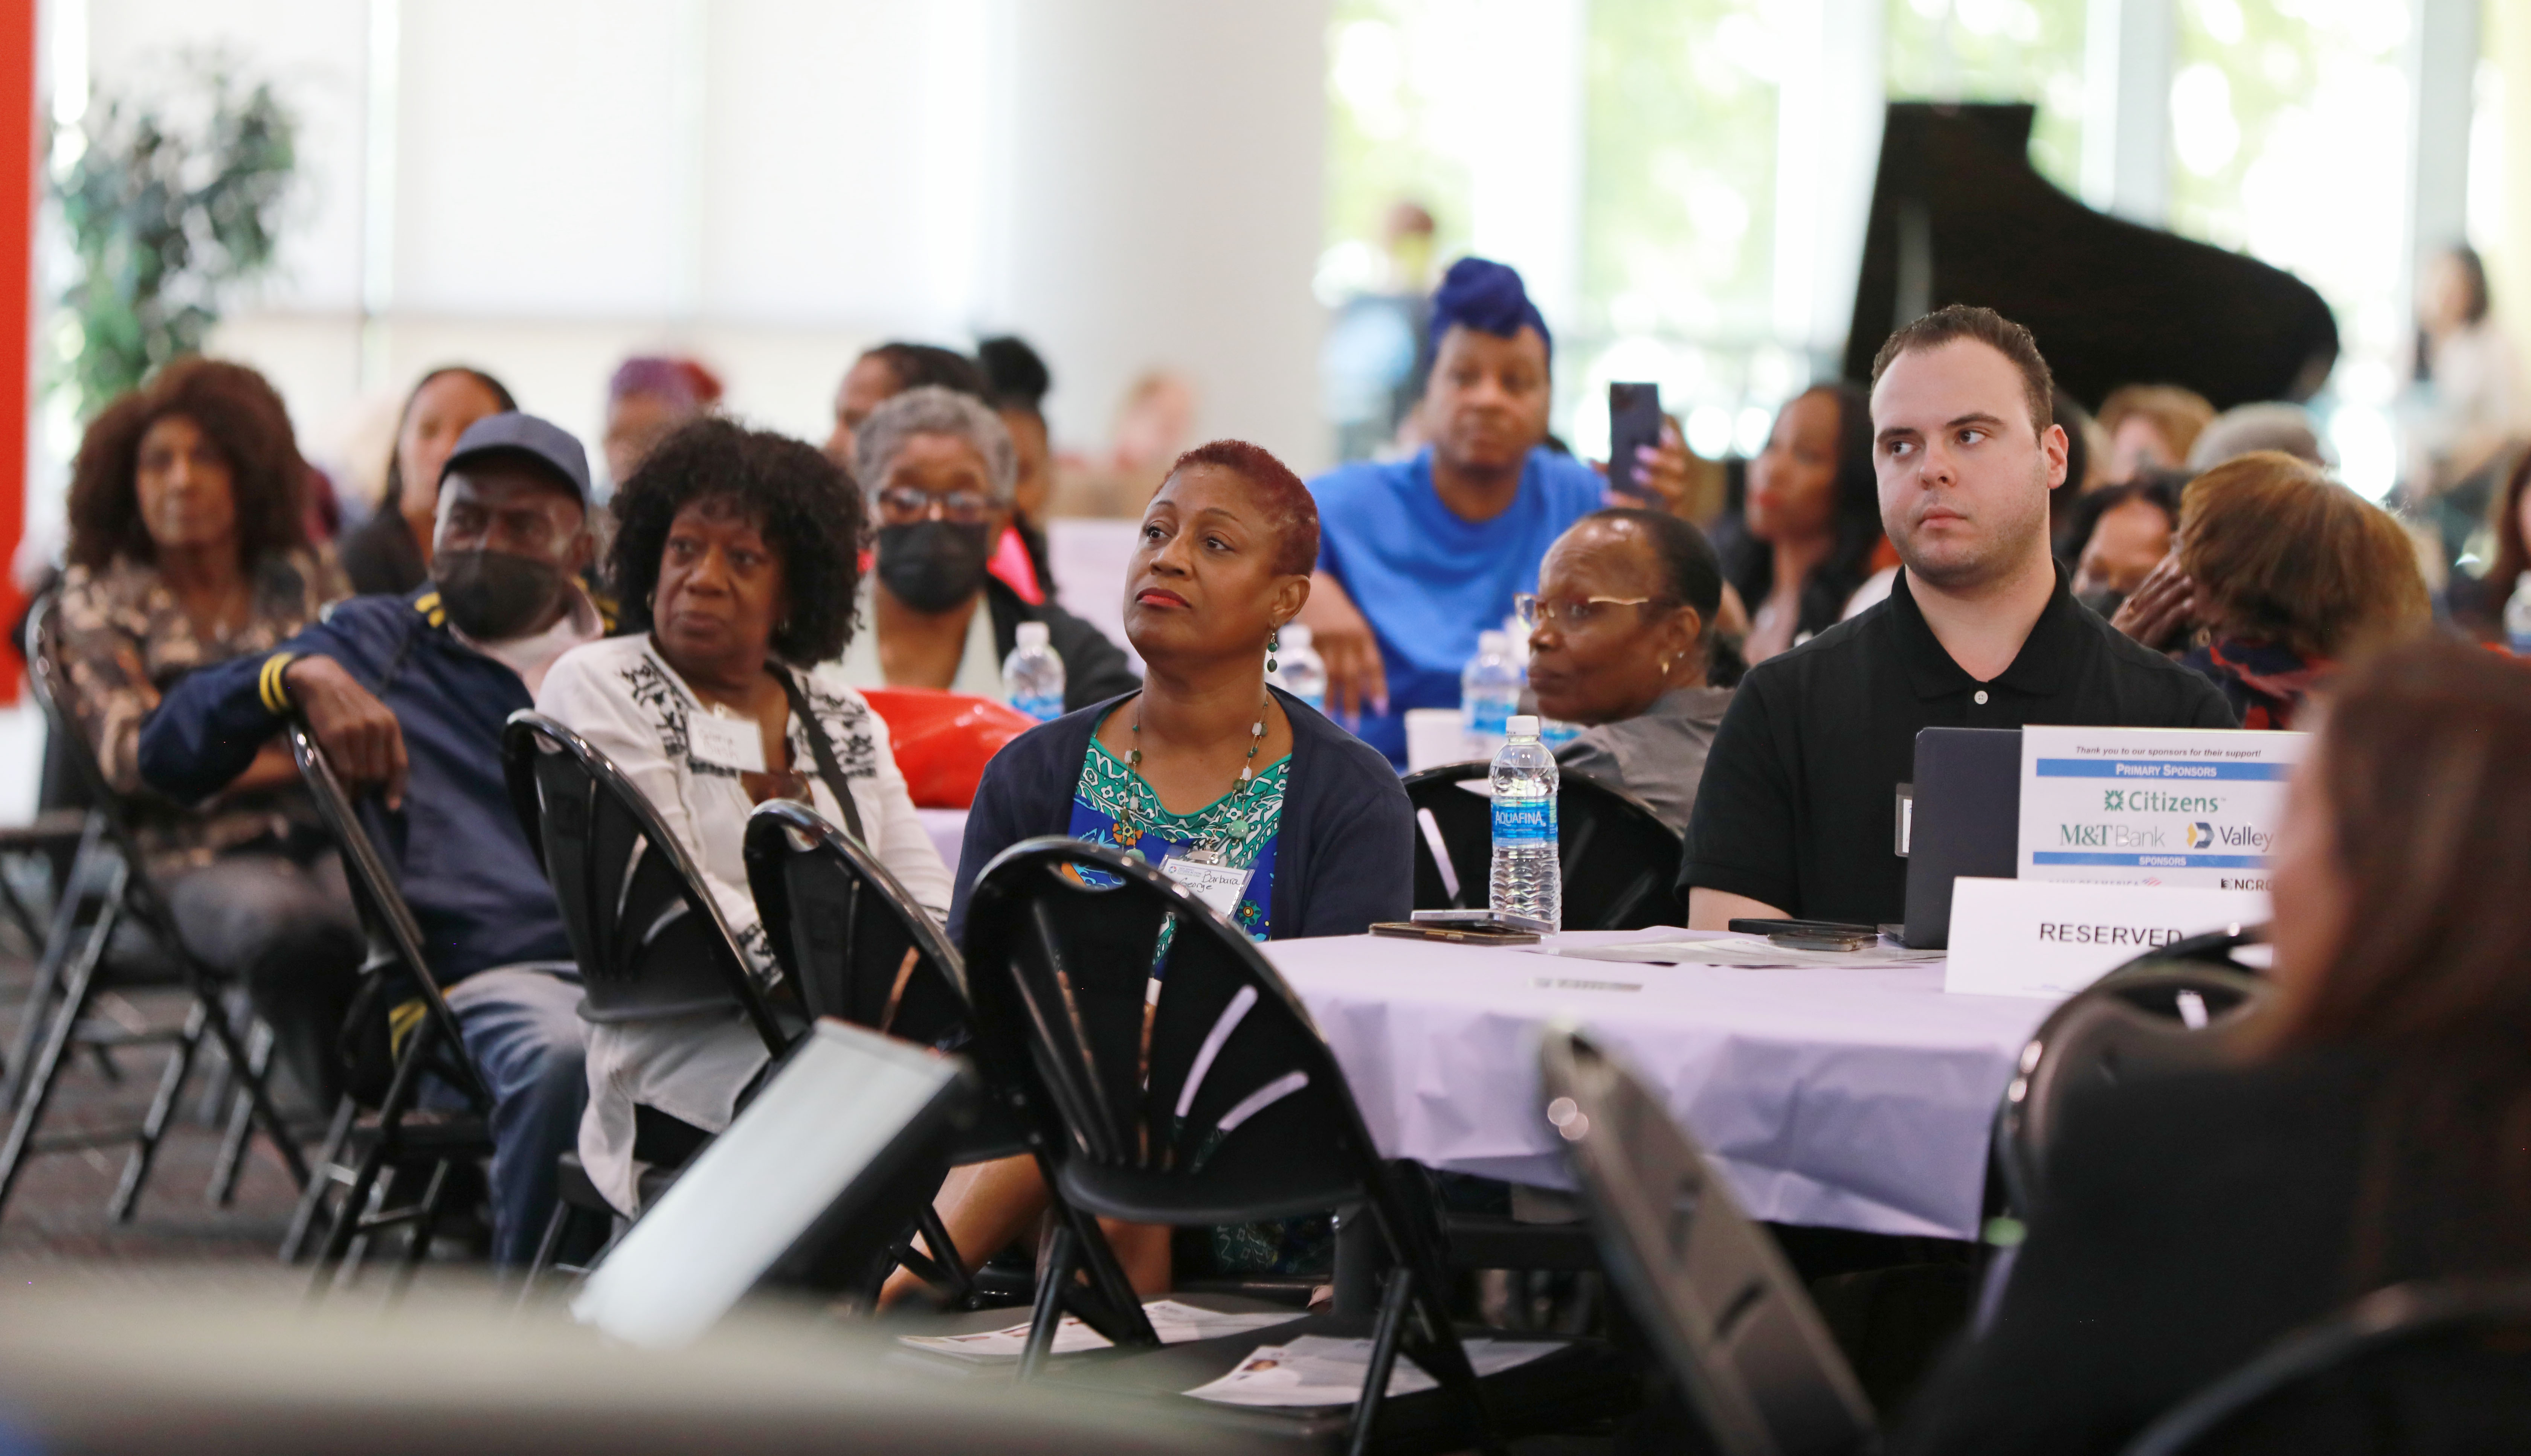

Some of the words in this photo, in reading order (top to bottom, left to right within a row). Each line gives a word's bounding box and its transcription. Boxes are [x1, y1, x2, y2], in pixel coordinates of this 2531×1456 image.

[2116, 763, 2160, 775] PRIMARY
[2163, 764, 2217, 777] SPONSORS
[2129, 791, 2218, 813] Citizens
[1495, 811, 1543, 826] AQUAFINA
[2060, 824, 2113, 846] M&T
[2116, 825, 2165, 847] Bank
[2220, 826, 2273, 852] Valley
[2139, 856, 2186, 866] SPONSORS
[1179, 878, 1213, 893] George
[1201, 871, 1240, 885] Barbara
[2040, 923, 2183, 948] RESERVED
